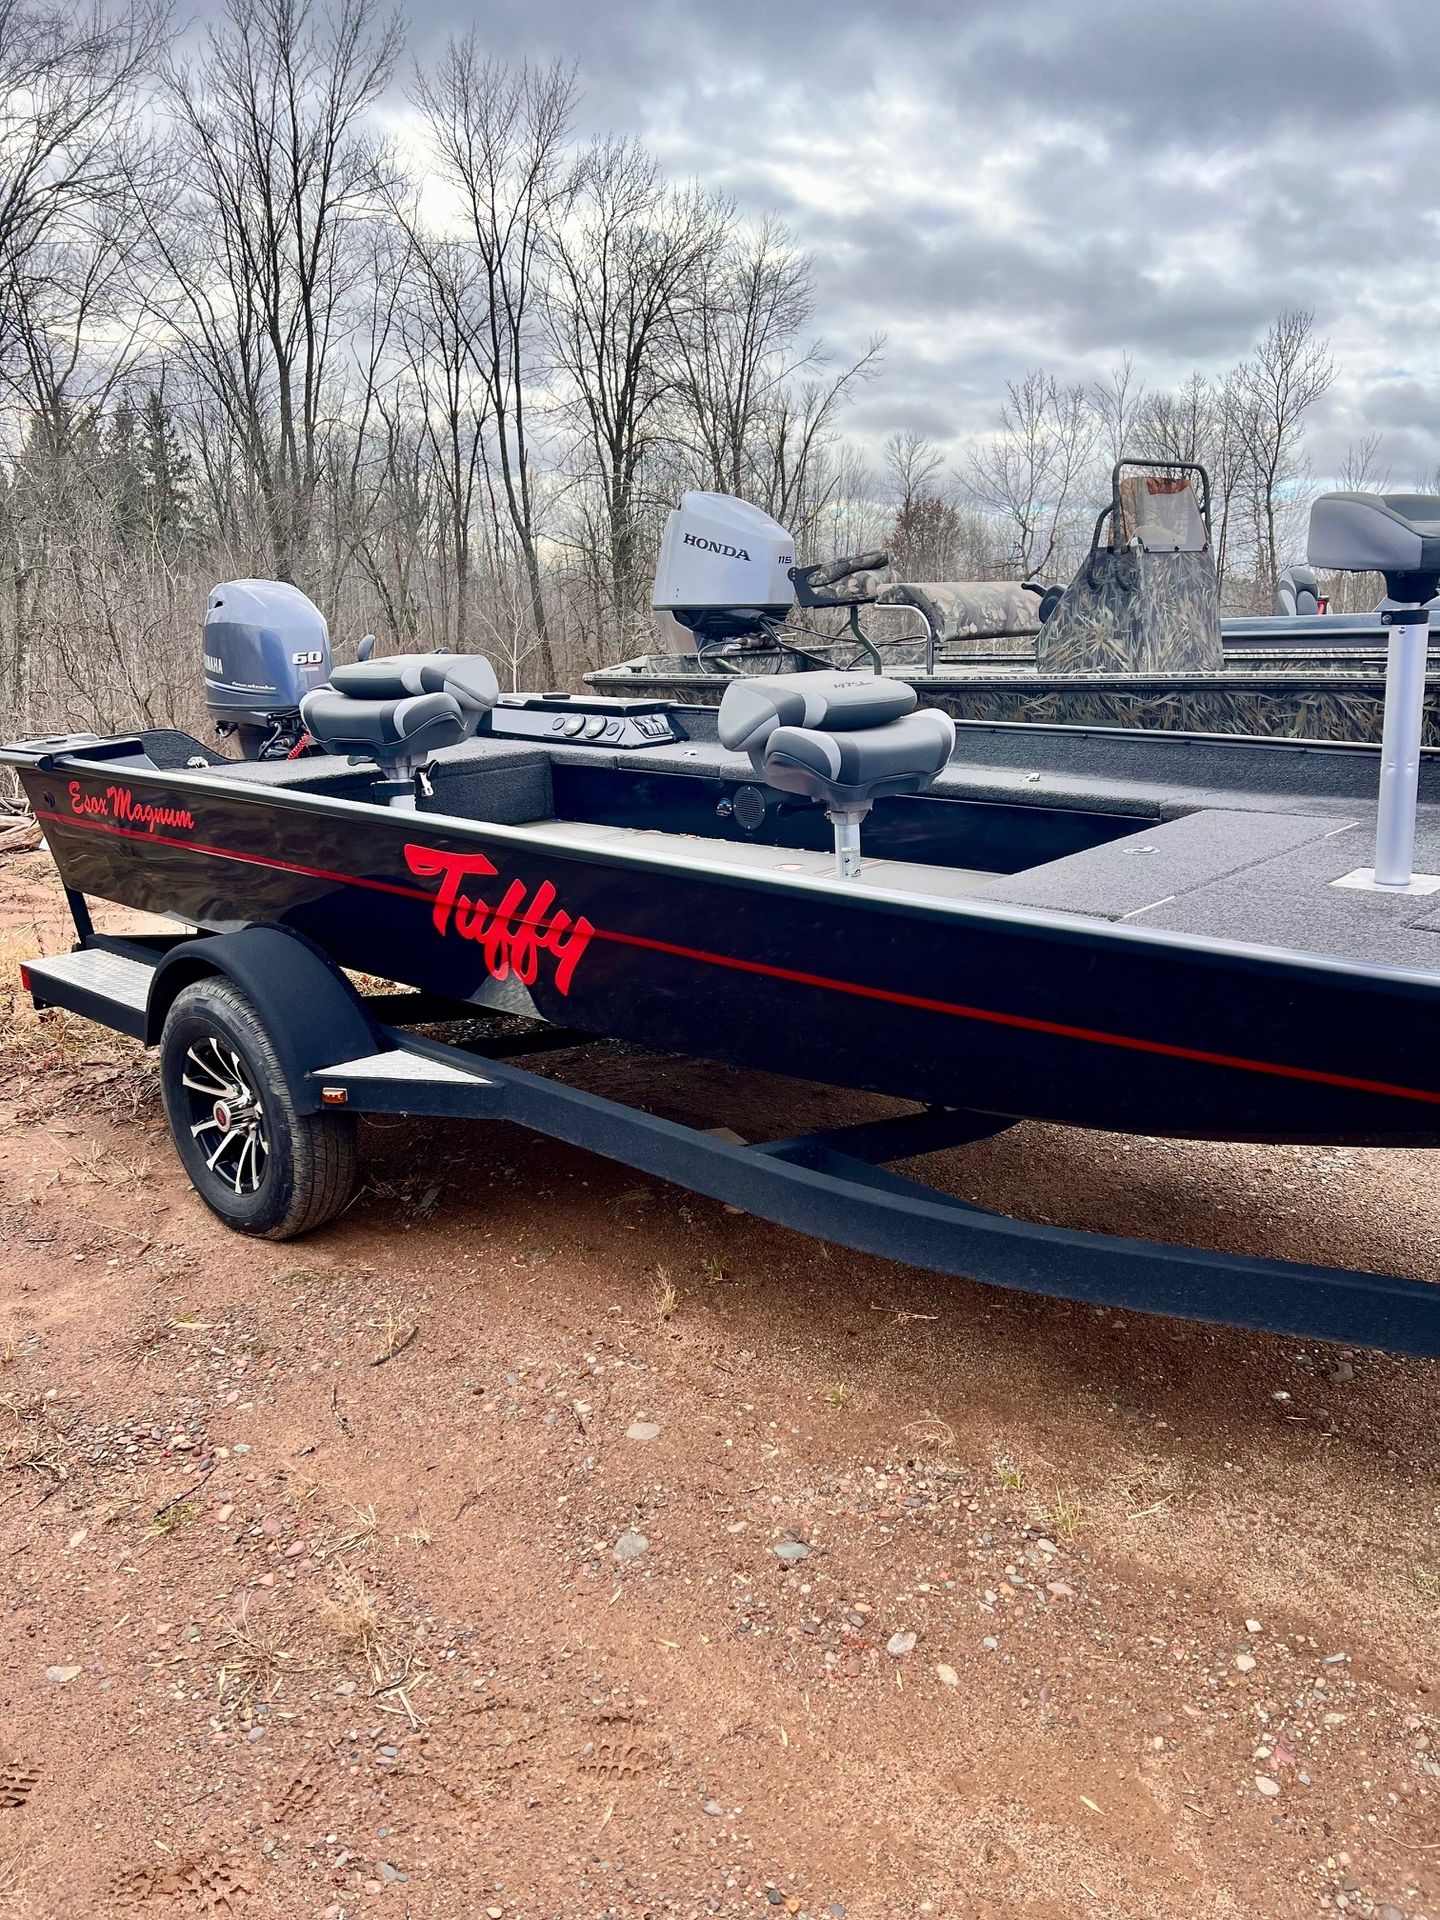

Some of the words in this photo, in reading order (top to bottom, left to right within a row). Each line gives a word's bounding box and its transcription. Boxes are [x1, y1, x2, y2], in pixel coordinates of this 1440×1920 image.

[683, 532, 752, 562] HONDA
[778, 555, 793, 565] 115
[292, 651, 323, 665] 60
[68, 780, 109, 816] Esox
[106, 785, 195, 833] Magnum
[403, 843, 596, 997] Tuffy
